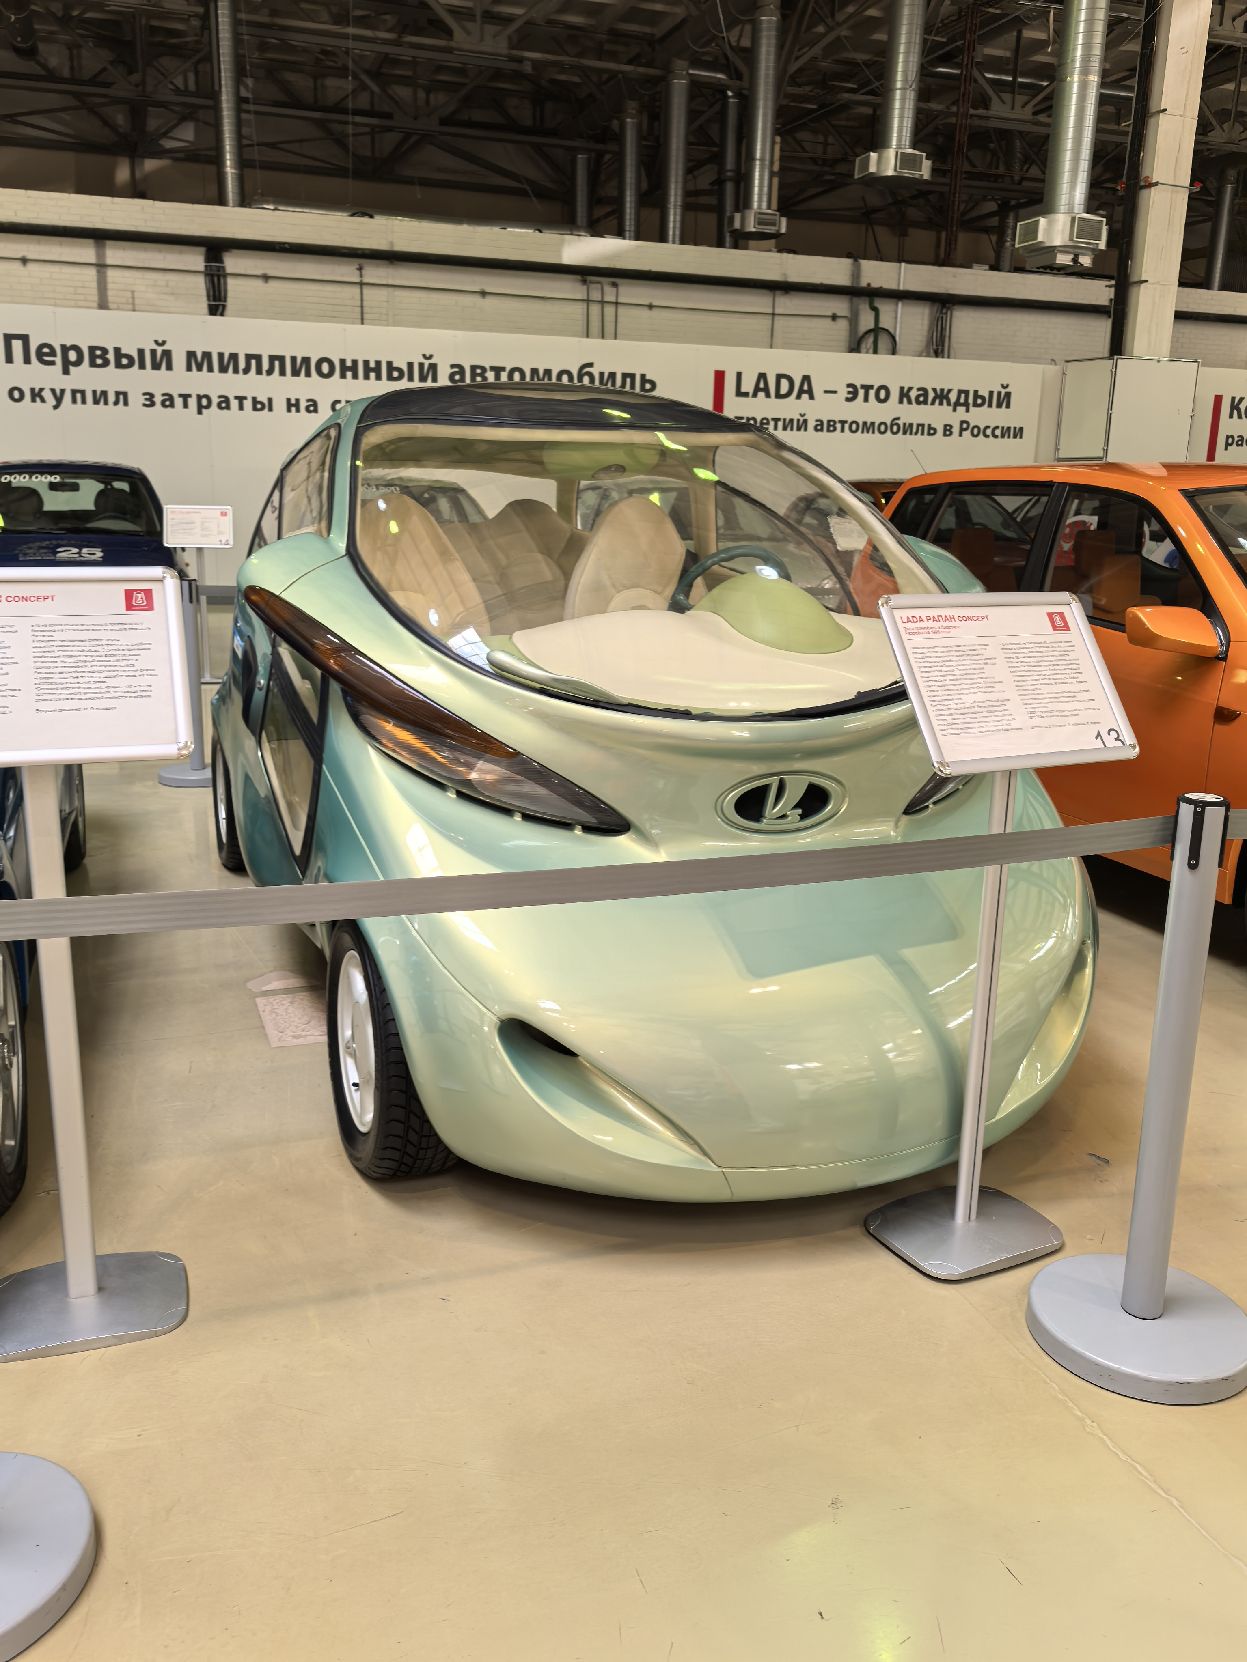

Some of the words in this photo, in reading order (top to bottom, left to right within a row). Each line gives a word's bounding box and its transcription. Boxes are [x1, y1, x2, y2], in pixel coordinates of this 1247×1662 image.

[3, 333, 173, 375] Первый
[185, 350, 439, 384] миллионный
[448, 362, 658, 393] автомобиль
[7, 386, 129, 411] окупил
[141, 391, 273, 415] затраты
[286, 397, 319, 414] на
[735, 372, 815, 400] LADA
[844, 383, 891, 404] это
[898, 383, 1012, 413] каждый
[813, 417, 938, 437] автомобиль
[942, 424, 954, 437] в
[958, 420, 1024, 440] России
[56, 547, 104, 558] 25
[5, 595, 56, 603] CONCEPT
[900, 615, 924, 624] LADA
[1095, 728, 1126, 748] 13
